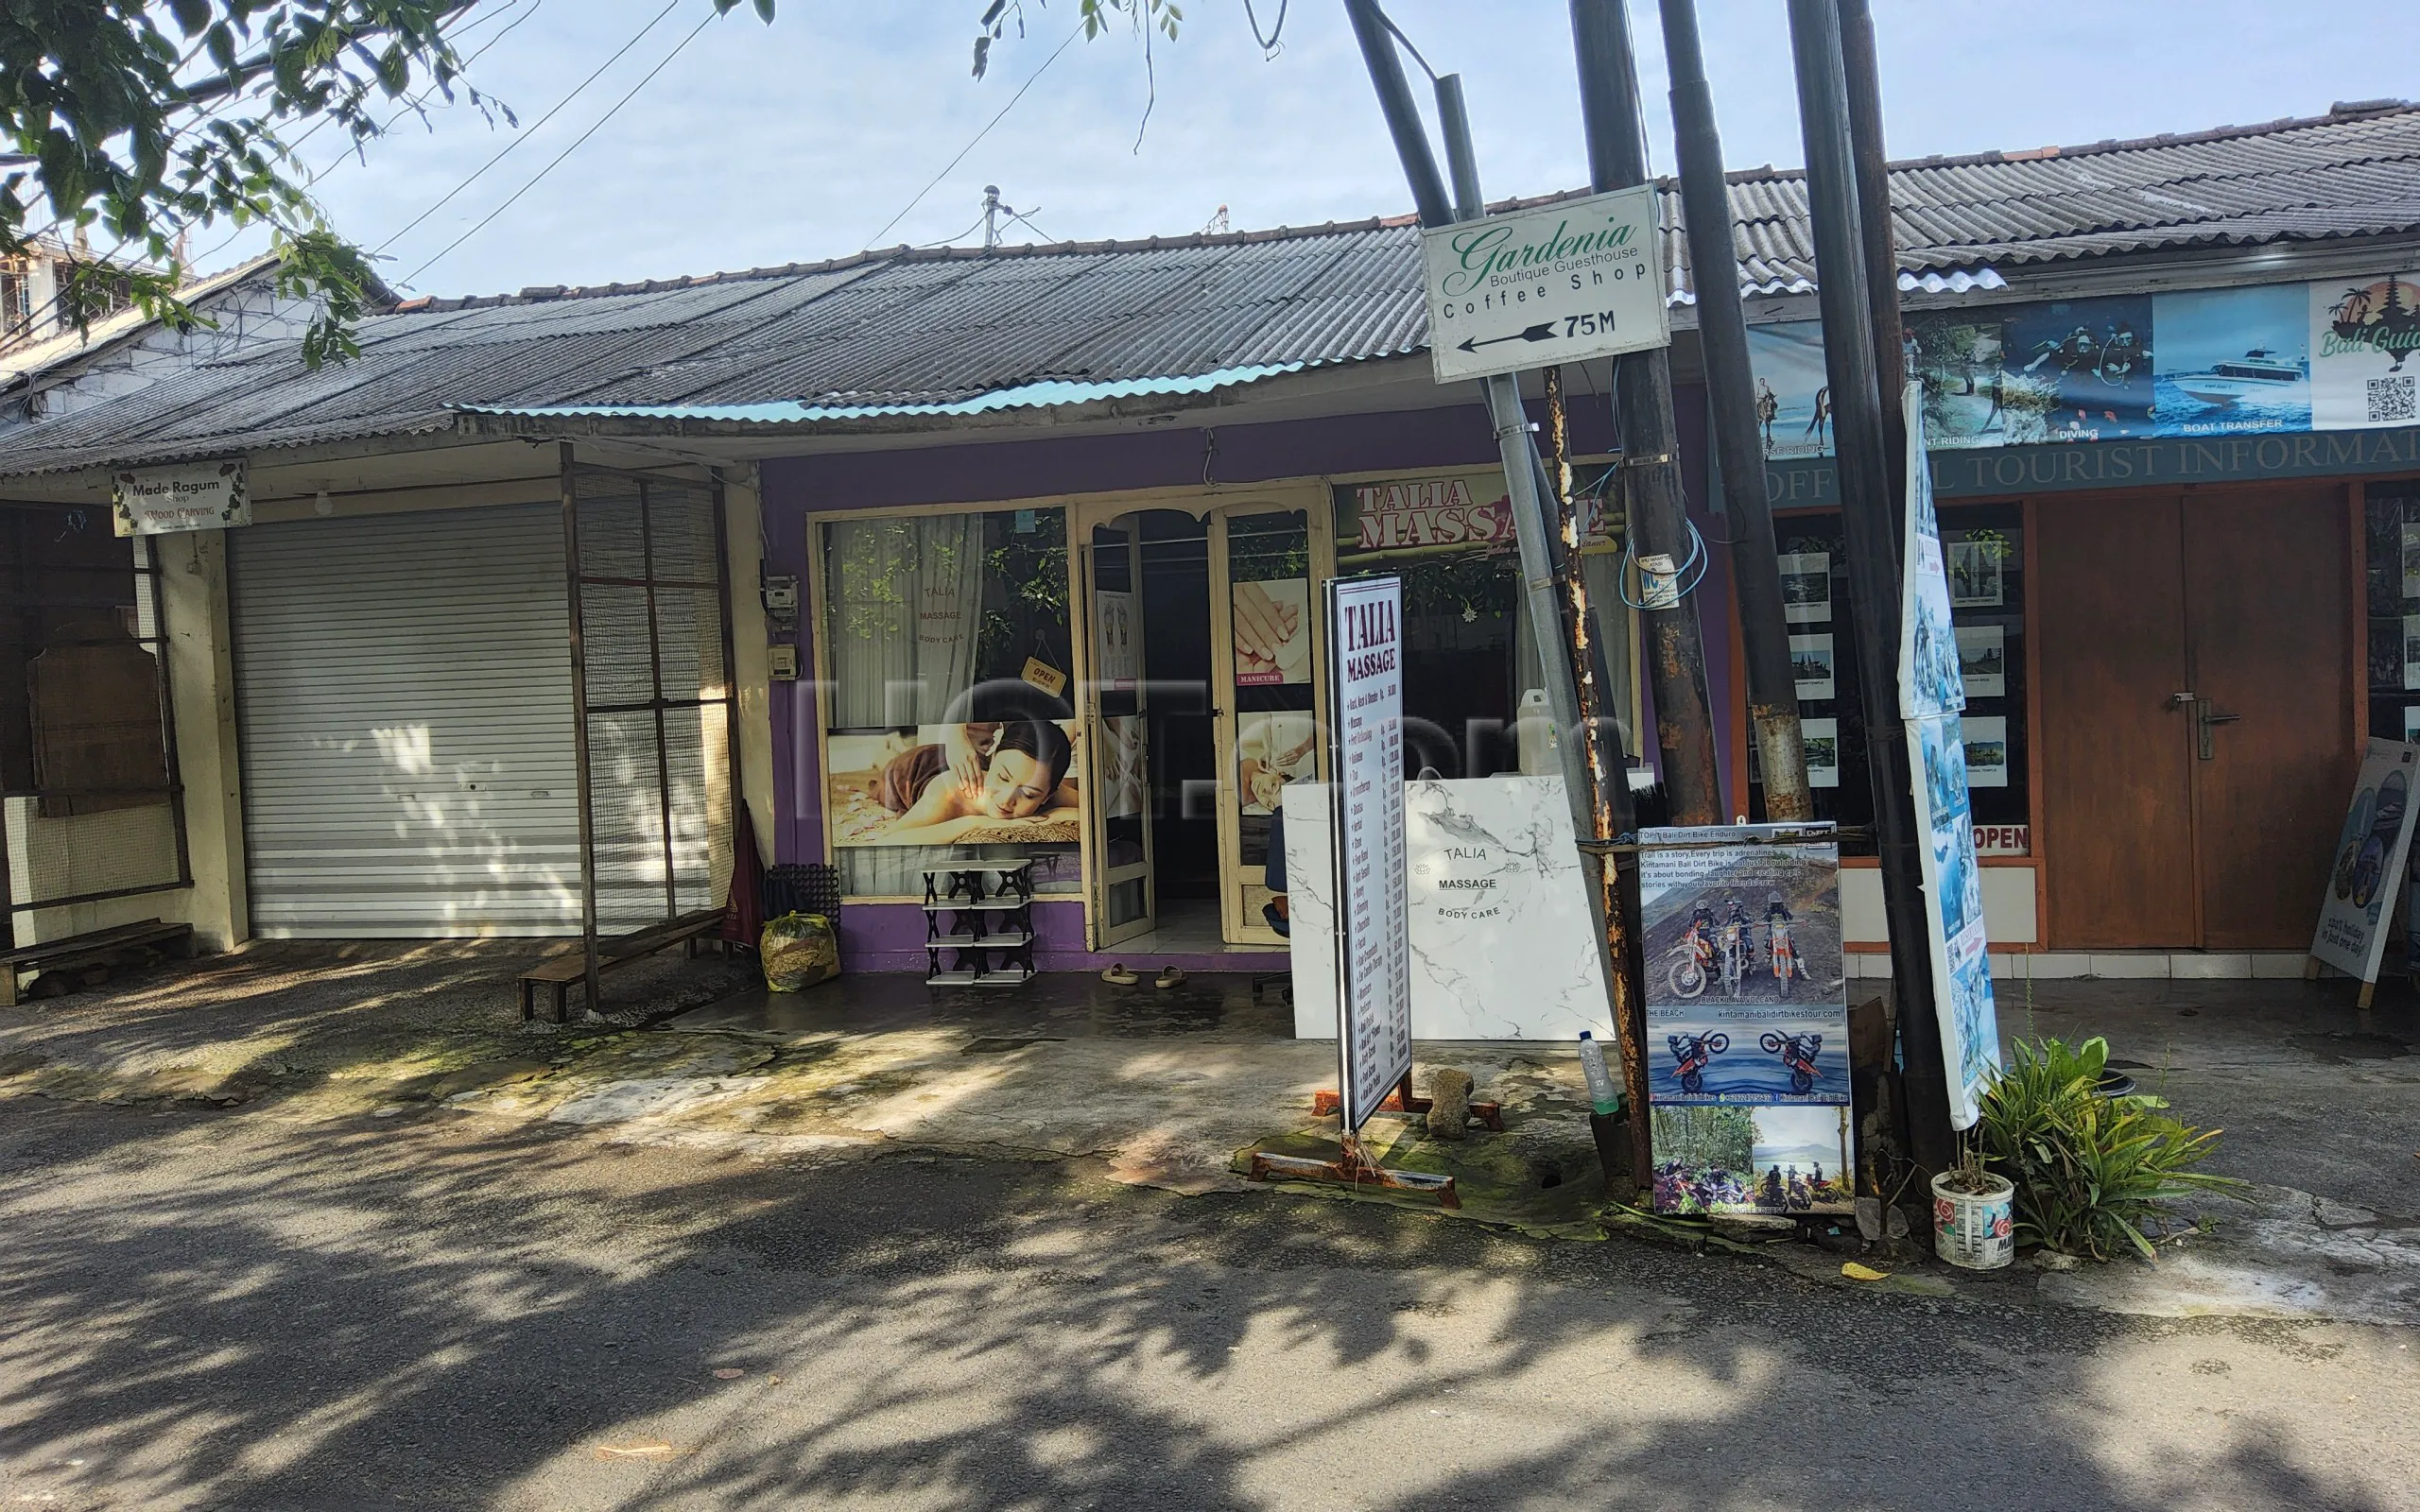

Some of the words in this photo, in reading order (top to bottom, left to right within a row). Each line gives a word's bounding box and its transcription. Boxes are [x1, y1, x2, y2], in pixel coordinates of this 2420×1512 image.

[1443, 216, 1637, 297] Gardenia
[1490, 266, 1550, 288] Boutique
[1554, 246, 1638, 273] Guesthouse
[1443, 285, 1547, 318] Coffee
[1570, 262, 1646, 289] Shop
[1564, 310, 1616, 339] 75M
[2319, 327, 2369, 357] Bali
[2183, 421, 2217, 433] BOAT
[2220, 419, 2283, 431] TRANSFER
[2059, 428, 2099, 439] DIVING
[1941, 436, 1980, 446] RIDING
[1762, 447, 1785, 457] RSE
[1787, 445, 1824, 455] RIDING
[1965, 445, 2164, 488] TOURIST
[132, 482, 169, 496] Made
[173, 481, 219, 495] Ragum
[166, 494, 189, 504] Shop
[1357, 480, 1473, 513] TALIA
[1357, 497, 1607, 550] MASSE
[925, 587, 955, 597] TALIA
[920, 611, 961, 620] MASSAGE
[1345, 599, 1395, 652] TALIA
[919, 634, 941, 644] BODY
[942, 633, 964, 644] CARE
[1347, 648, 1395, 683] MASSAGE
[1033, 667, 1056, 683] OPEN
[1240, 675, 1280, 683] MANICURE
[1973, 828, 2028, 849] OPEN
[1443, 847, 1487, 861] TALIA
[1712, 850, 1725, 859] trip
[1439, 879, 1497, 889] MASSAGE
[1438, 907, 1468, 919] BODY
[1471, 906, 1501, 919] CARE
[1746, 995, 1780, 1004] VOLCANO
[1718, 1009, 1841, 1019] kintamanibalidirtbikestour.com
